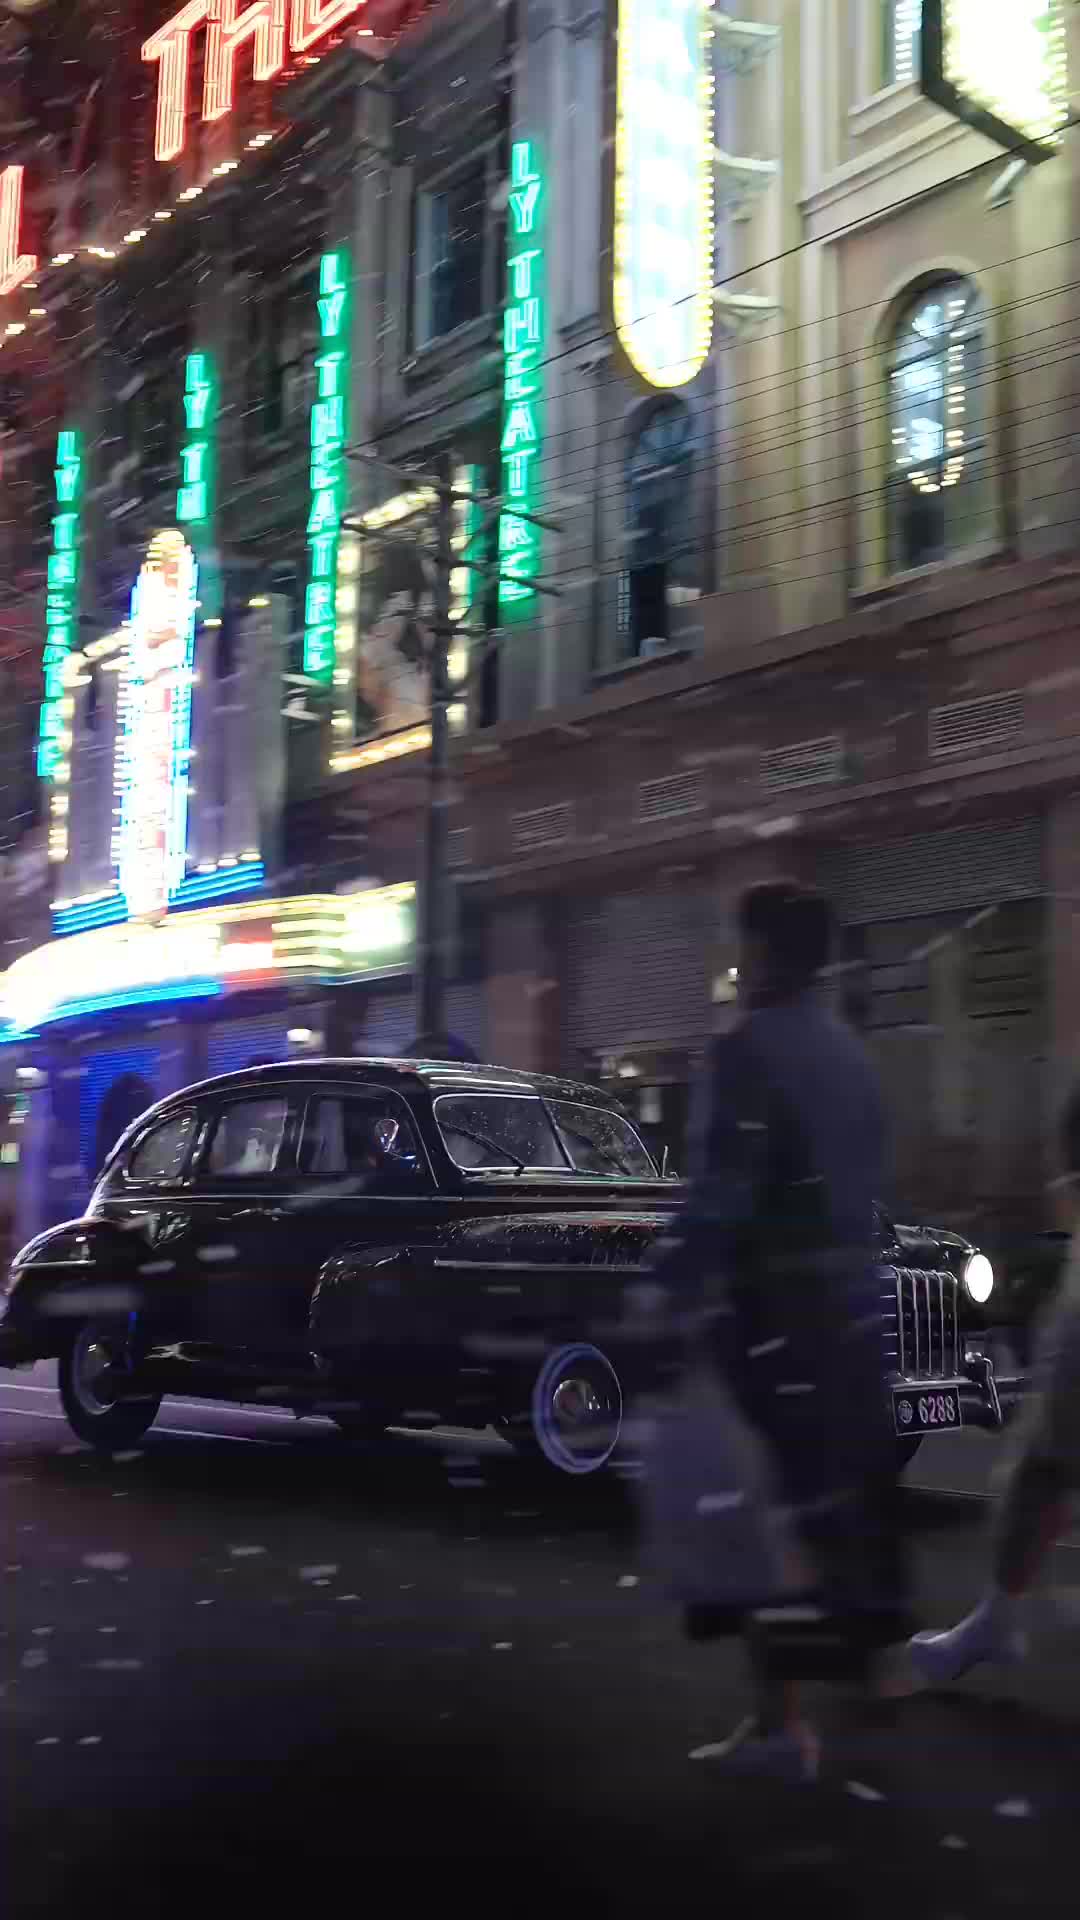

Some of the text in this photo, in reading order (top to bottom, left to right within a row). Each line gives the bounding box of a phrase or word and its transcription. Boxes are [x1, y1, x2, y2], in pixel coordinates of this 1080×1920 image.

[317, 253, 346, 337] LY
[498, 141, 543, 603] LY THEATRE
[918, 1395, 956, 1424] 6288
